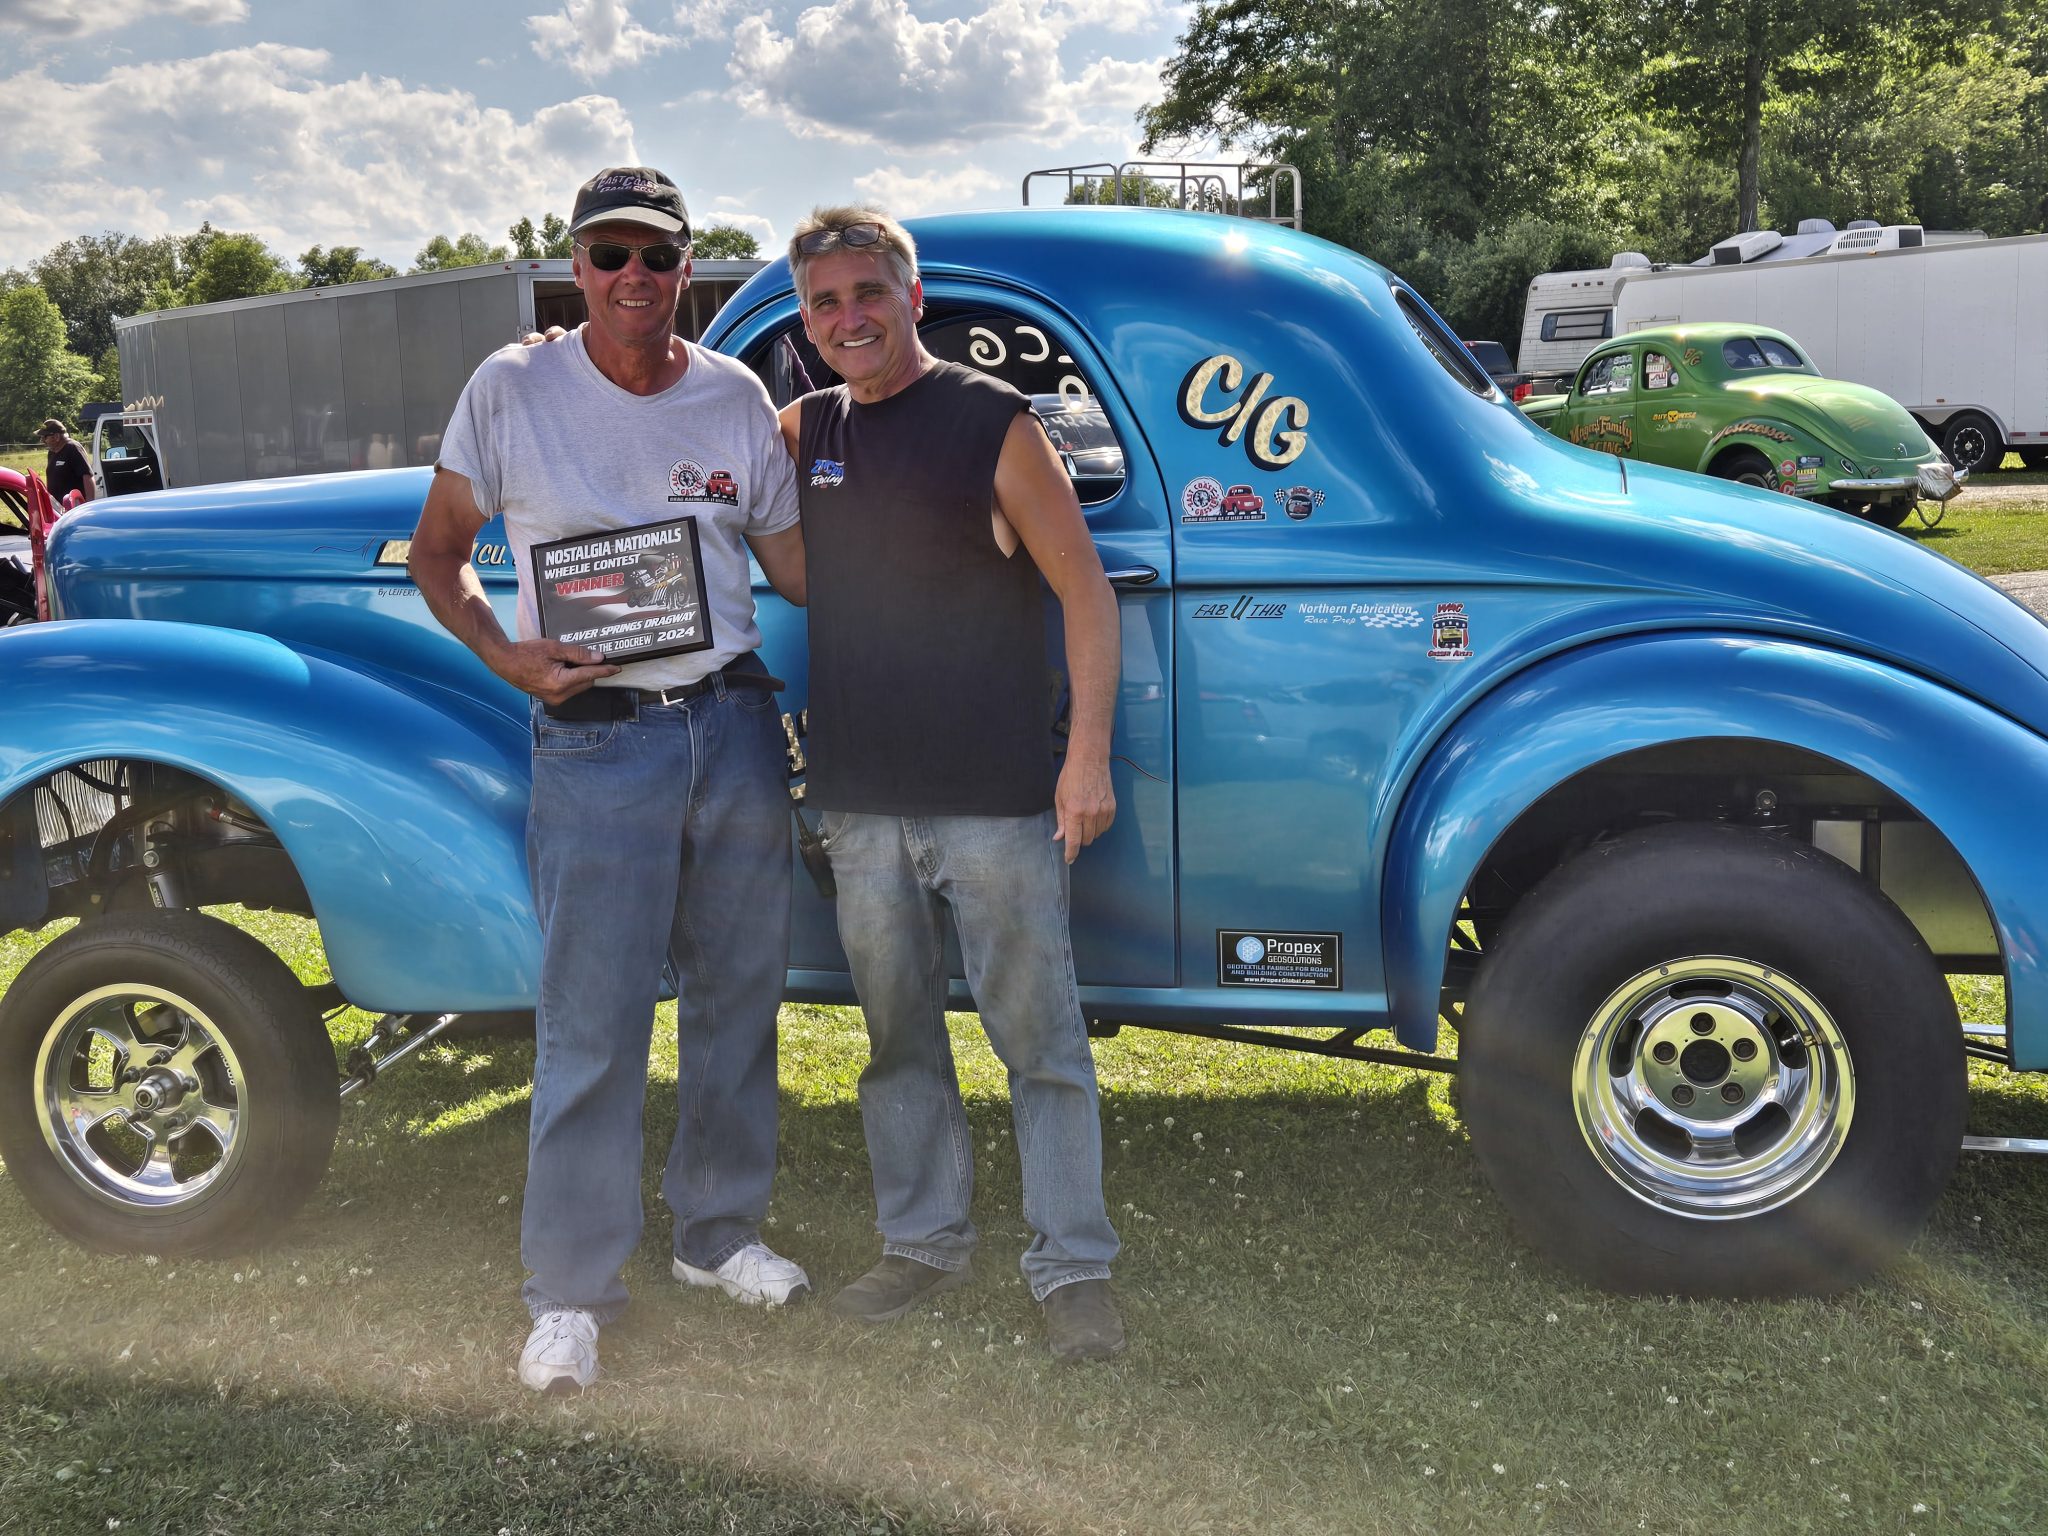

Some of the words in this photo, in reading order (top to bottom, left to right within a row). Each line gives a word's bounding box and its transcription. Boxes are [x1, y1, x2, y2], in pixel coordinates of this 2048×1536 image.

[1178, 354, 1310, 471] C/G
[1599, 416, 1632, 449] Family
[545, 544, 611, 567] NOSTALGIA
[614, 527, 682, 554] NATIONALS
[544, 563, 591, 580] WHEELIE
[593, 553, 641, 571] CONTEST
[555, 572, 625, 597] WINNER
[1194, 604, 1229, 616] FAB
[1230, 595, 1254, 620] U
[1250, 603, 1287, 616] THIS
[1298, 603, 1347, 614] Northern
[1350, 603, 1413, 614] Fabrication
[559, 629, 599, 643] BEAVER
[599, 620, 642, 637] SPRINGS
[643, 610, 697, 629] DRAGWAY
[1303, 615, 1328, 624] Race
[1331, 615, 1356, 625] Prep
[598, 641, 613, 653] THE
[614, 634, 652, 651] ZOOCREW
[656, 626, 696, 642] 2024
[1267, 938, 1322, 957] Propex
[1226, 963, 1266, 971] GEOTEXTILE
[1267, 955, 1322, 965] GEOSOLUTIONS
[1278, 970, 1329, 978] CONSTRUCTION
